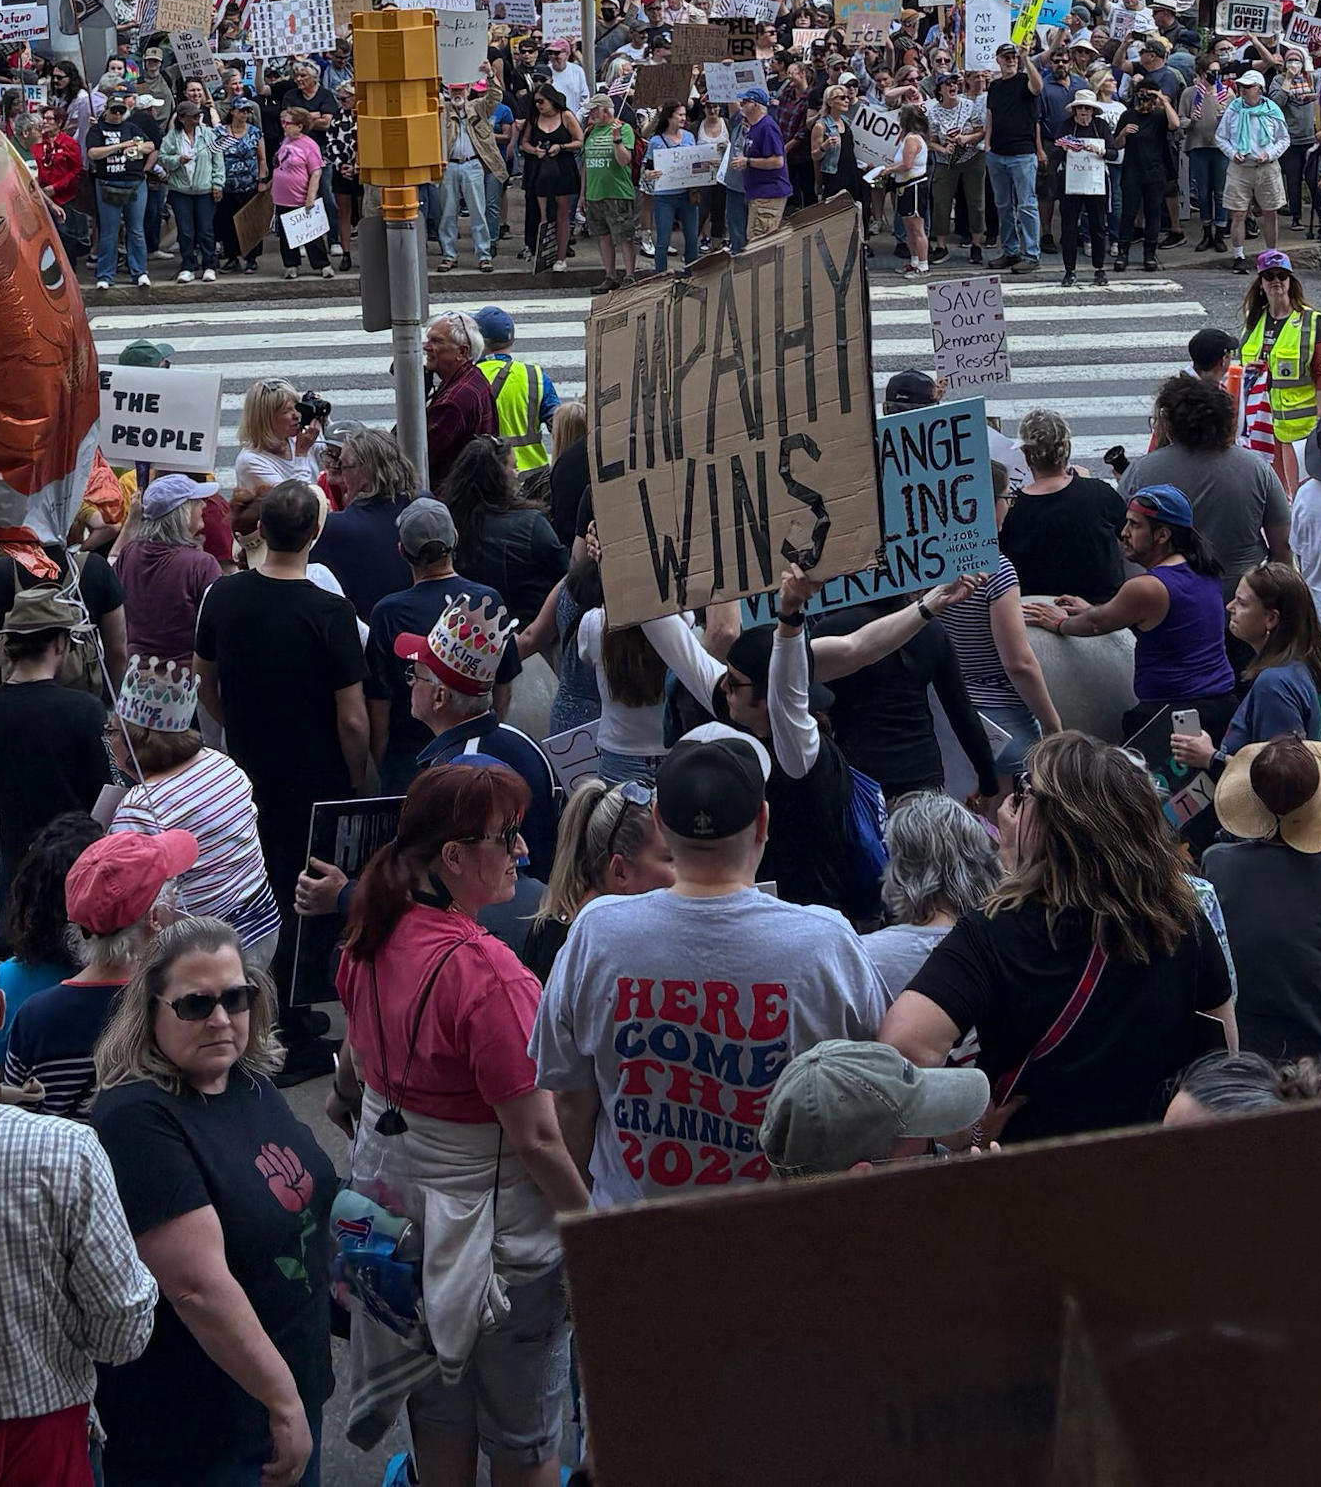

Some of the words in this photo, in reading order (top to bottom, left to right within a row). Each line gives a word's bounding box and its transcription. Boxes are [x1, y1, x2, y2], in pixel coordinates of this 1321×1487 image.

[975, 13, 992, 23] MY
[1234, 16, 1263, 31] OFF!
[1235, 7, 1265, 18] HANDS
[1293, 16, 1309, 33] NO
[179, 33, 193, 41] NO
[852, 29, 884, 44] ICE
[975, 25, 997, 33] ONLY
[177, 41, 203, 51] KINGS
[595, 223, 860, 482] EMPATHY
[932, 328, 1006, 354] Democracy
[955, 349, 1000, 369] Resist
[944, 363, 1011, 391] Trump!
[113, 391, 160, 413] THE
[111, 424, 204, 452] PEOPLE
[881, 414, 976, 478] ANGE
[638, 432, 832, 606] WINS
[450, 642, 482, 670] King
[614, 977, 789, 1041] HERE
[614, 1021, 789, 1088] COME
[618, 1058, 775, 1126] THE
[618, 1130, 773, 1188] 2024
